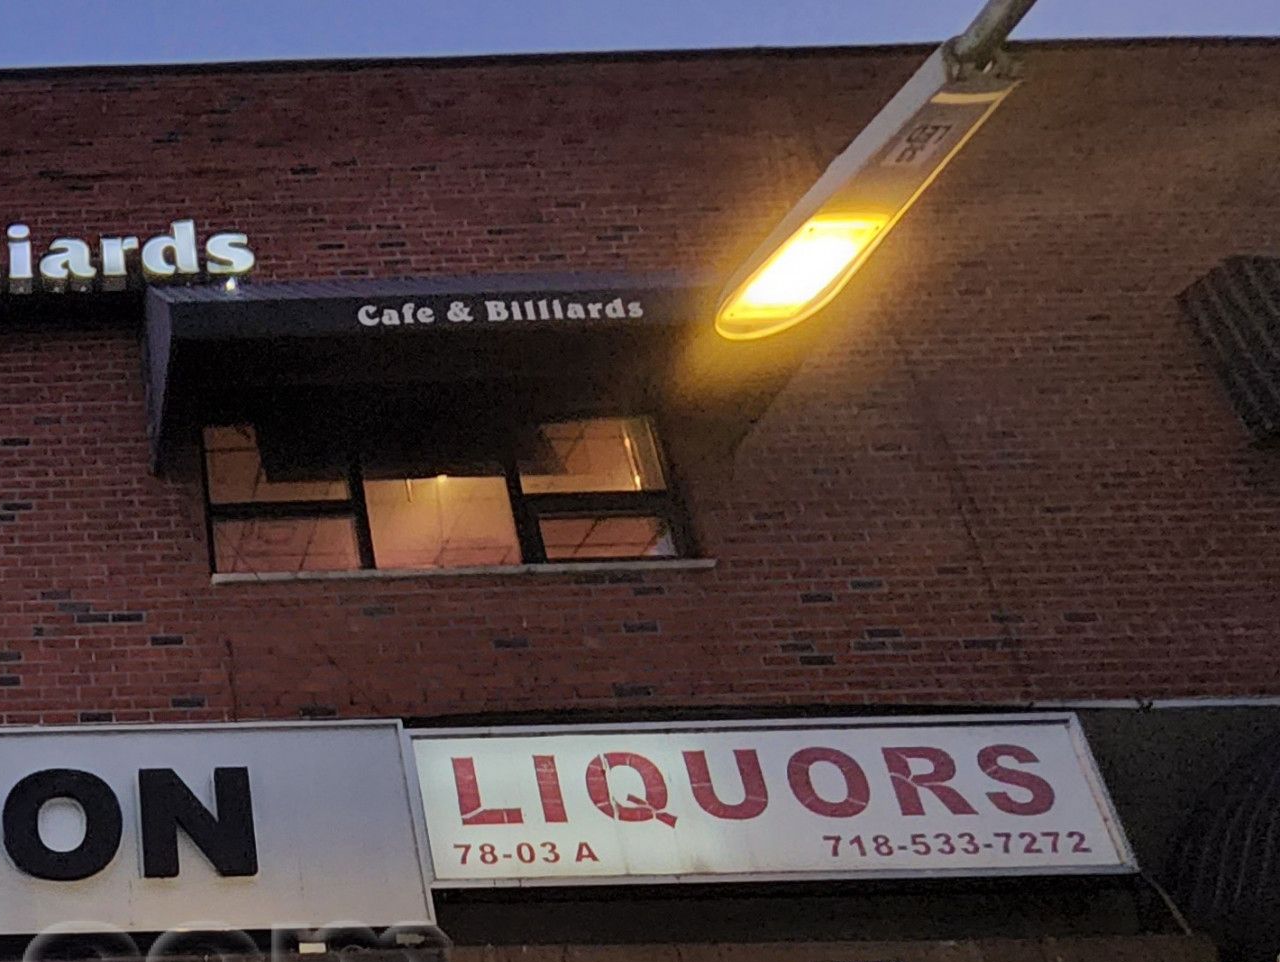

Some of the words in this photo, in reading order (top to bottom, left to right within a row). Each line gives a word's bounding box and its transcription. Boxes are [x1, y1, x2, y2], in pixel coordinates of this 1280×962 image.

[357, 303, 435, 326] Cafe
[447, 301, 473, 322] &
[484, 298, 643, 321] Billiards
[451, 744, 1056, 829] LIQUORS
[453, 842, 561, 866] 78-03
[575, 841, 600, 864] A
[823, 832, 1093, 859] 718-533-7272
